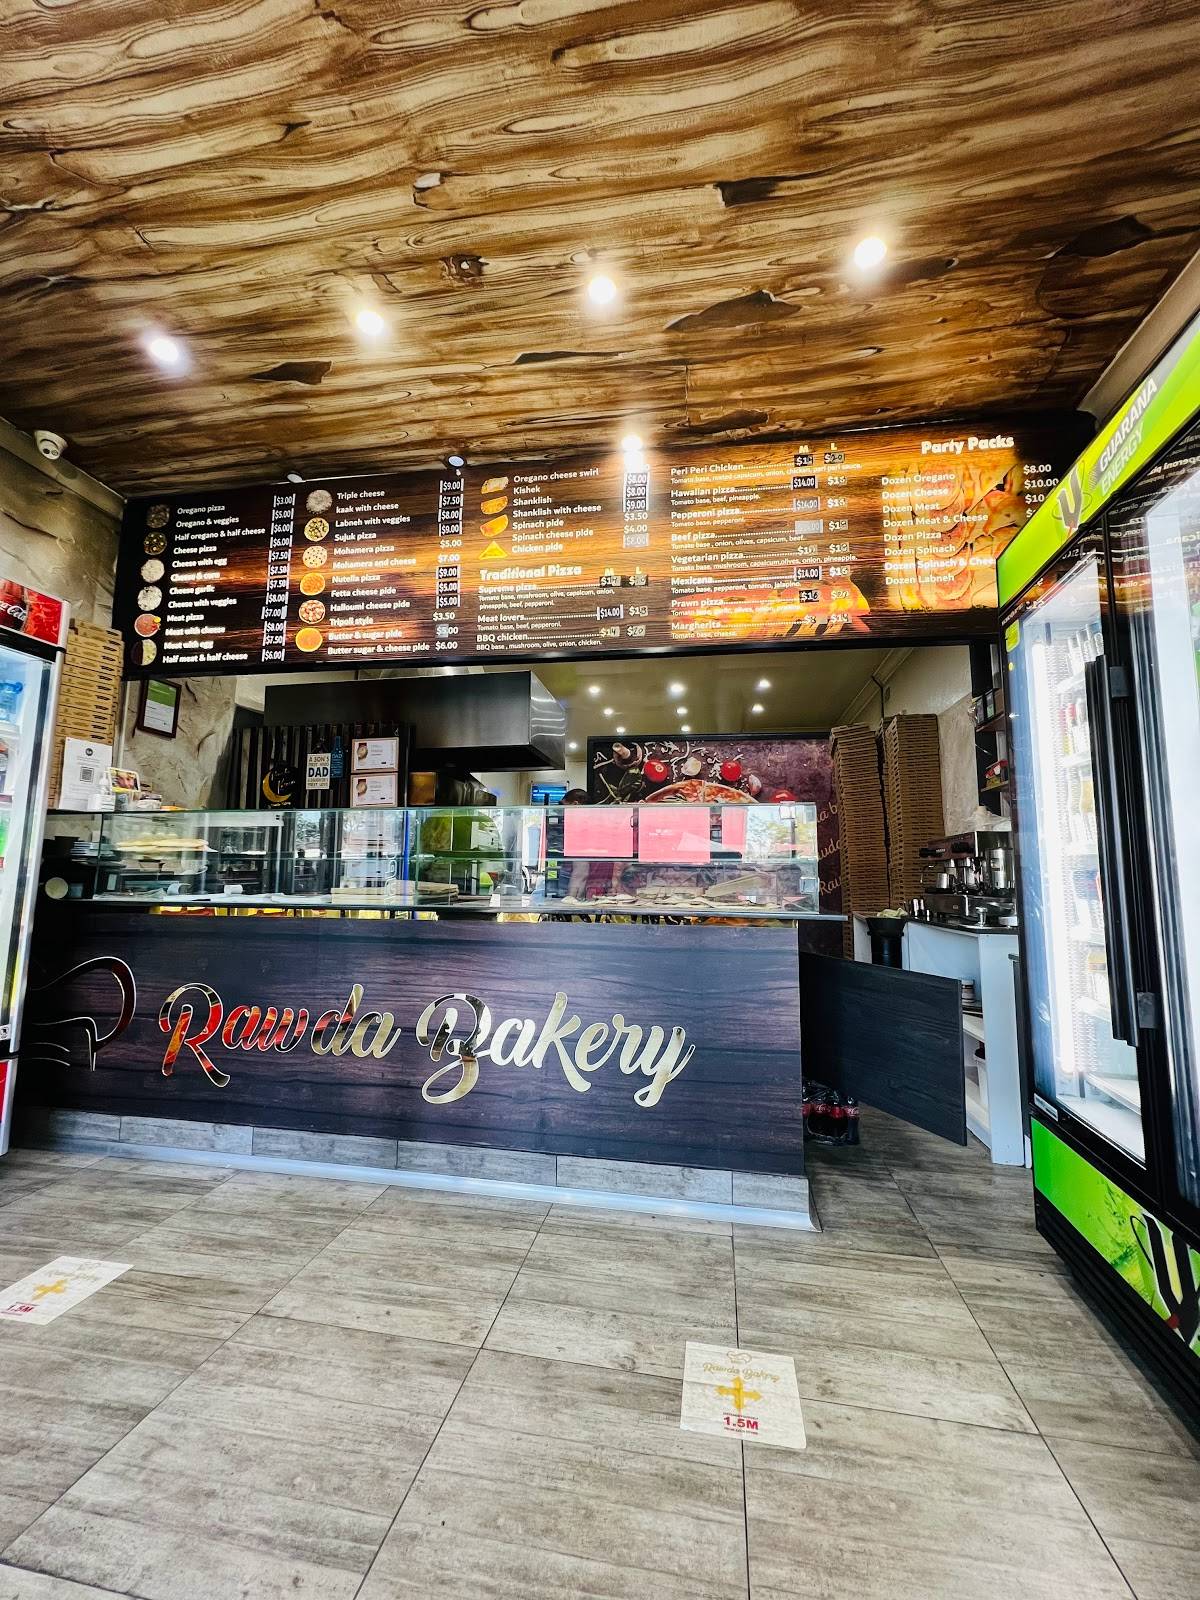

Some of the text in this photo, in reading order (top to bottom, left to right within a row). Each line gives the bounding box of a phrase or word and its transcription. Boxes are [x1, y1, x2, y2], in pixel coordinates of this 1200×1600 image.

[1100, 378, 1157, 471] GUARANA
[799, 445, 809, 453] M
[921, 435, 1014, 455] Party Packs
[1102, 422, 1144, 496] ENERGY
[671, 468, 687, 476] Peri
[690, 466, 707, 474] Peri
[1024, 464, 1051, 474] $8.00
[514, 468, 599, 484] Oregano cheese swirl
[881, 473, 955, 485] Dozen Oregano
[443, 481, 460, 491] $9.00
[1024, 478, 1059, 488] $10.00
[337, 490, 385, 500] Triple cheese
[514, 486, 540, 494] Kishek
[882, 488, 949, 499] Dozen Cheese
[442, 495, 460, 505] $7.50
[627, 500, 645, 510] $9.00
[208, 505, 225, 513] pizza
[373, 502, 399, 510] cheese
[554, 504, 601, 514] with cheese
[883, 502, 940, 514] Dozen Meat
[213, 517, 239, 525] veggies
[335, 515, 410, 527] Labneh with veggies
[624, 512, 648, 521] $3.50
[883, 519, 913, 528] Dozen
[916, 517, 941, 525] Meat
[953, 513, 988, 522] Cheese
[512, 518, 564, 530] Spinach pide
[624, 524, 647, 533] $4.00
[175, 533, 189, 541] Half
[191, 532, 219, 540] oregano
[335, 532, 376, 542] Sujuk pizza
[512, 528, 593, 542] Spinach cheese pide
[884, 531, 942, 542] Dozen Pizza
[440, 539, 462, 548] $5.00
[199, 545, 217, 554] pizza
[375, 545, 394, 553] pizza
[884, 544, 955, 556] Dozen Spinach
[671, 552, 743, 565] Vegetarian pizza
[884, 562, 915, 570] Dozen
[480, 564, 582, 581] Traditional Pizza
[361, 574, 381, 583] pizza
[885, 574, 954, 585] Dozen Labneh
[352, 588, 378, 596] cheese
[380, 587, 396, 596] pide
[366, 602, 392, 610] cheese
[393, 600, 410, 609] pide
[671, 600, 698, 608] Prawn
[433, 612, 455, 621] $3.50
[477, 633, 528, 643] BBQ chicken
[385, 644, 411, 652] cheese
[413, 642, 429, 652] pide
[436, 642, 457, 650] $6.00
[163, 655, 179, 663] Half
[207, 653, 222, 661] half
[309, 767, 328, 777] DAD
[157, 983, 401, 1088] Rawda
[415, 991, 696, 1108] Bakery
[723, 1416, 758, 1430] 1.5M
